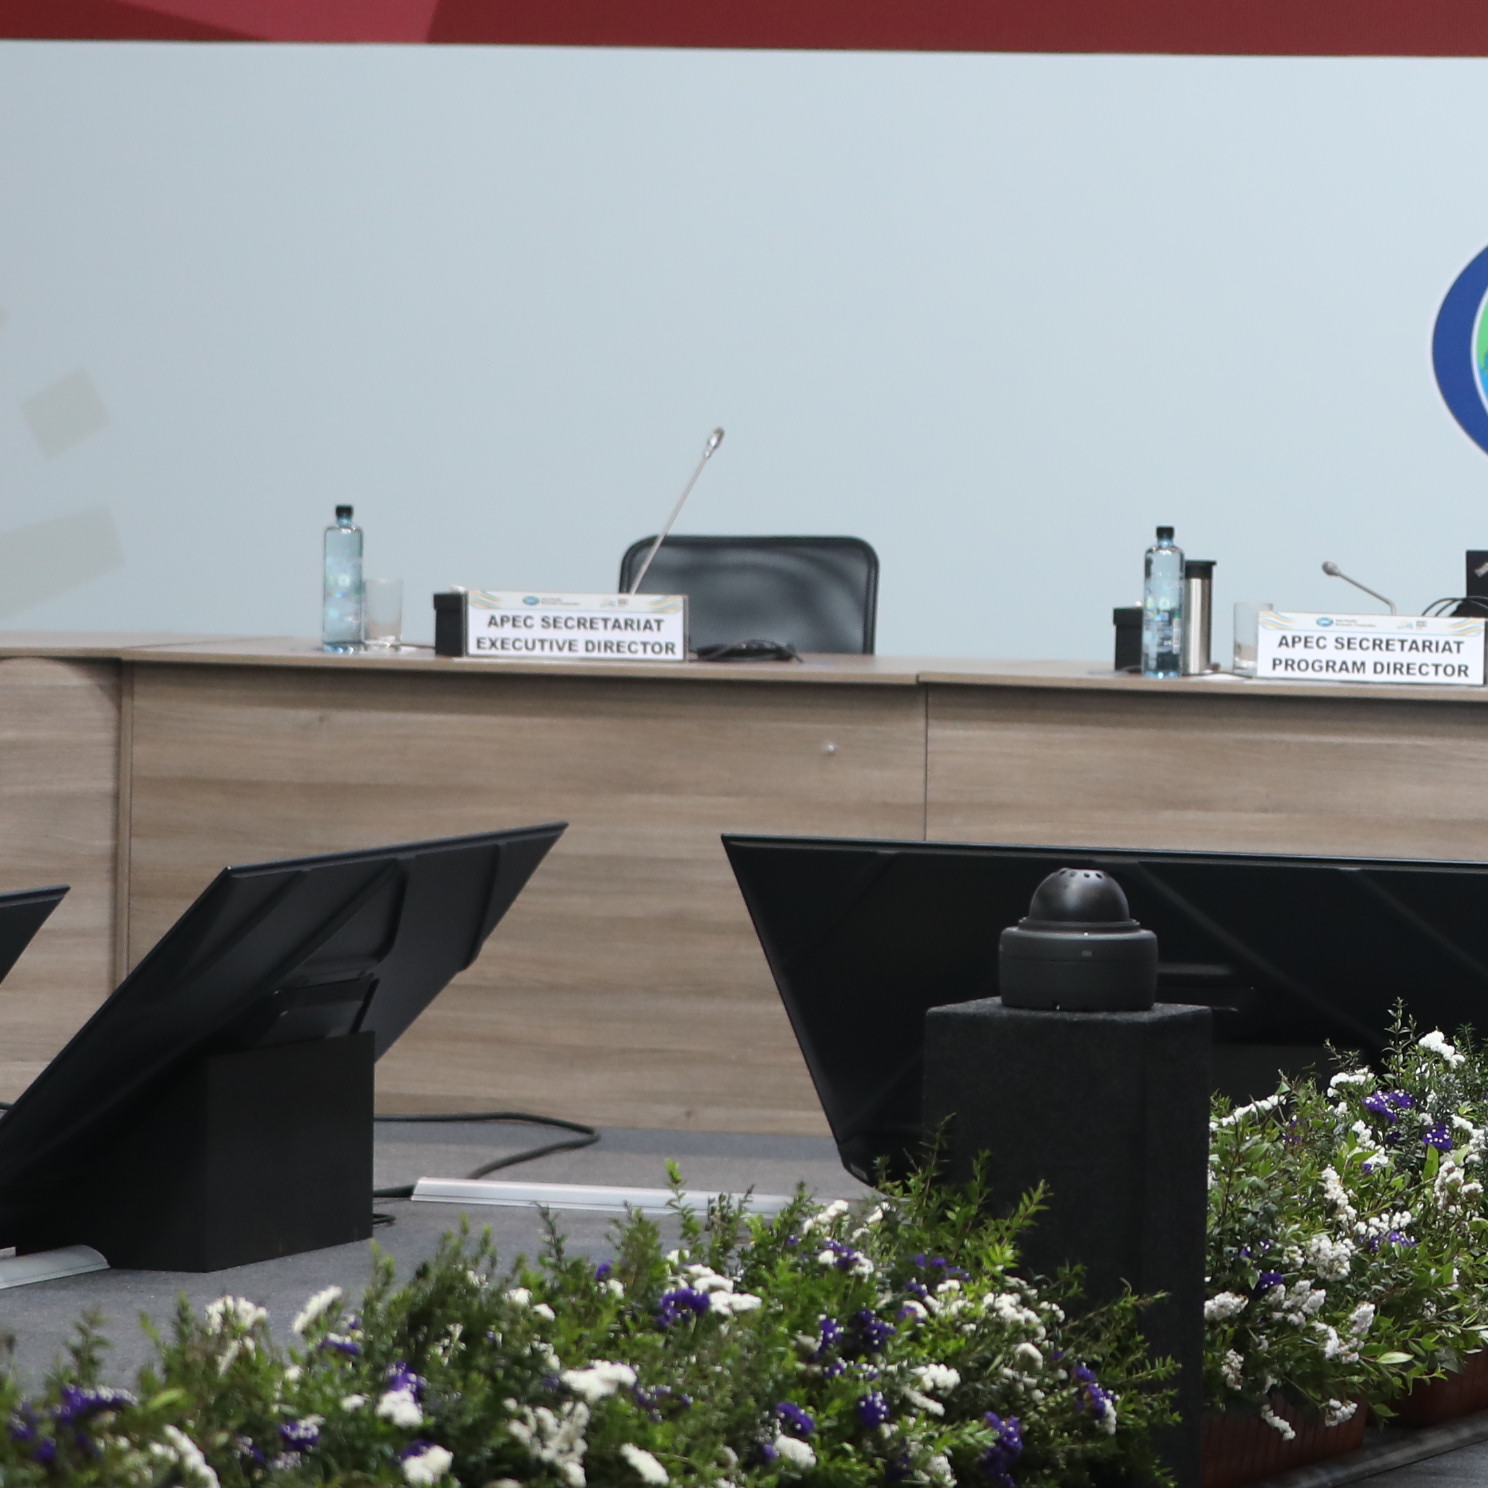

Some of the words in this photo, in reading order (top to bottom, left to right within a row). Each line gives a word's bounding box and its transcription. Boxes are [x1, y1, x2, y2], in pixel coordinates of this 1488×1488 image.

[487, 614, 533, 629] APEC
[540, 615, 665, 632] SECRETARIAT
[476, 637, 577, 653] EXECUTIVE
[583, 639, 676, 656] DIRECTOR
[1278, 635, 1327, 650] APEC
[1334, 636, 1465, 654] SECRETARIAT
[1272, 657, 1366, 675] PROGRAM
[1373, 661, 1470, 678] DIRECTOR
